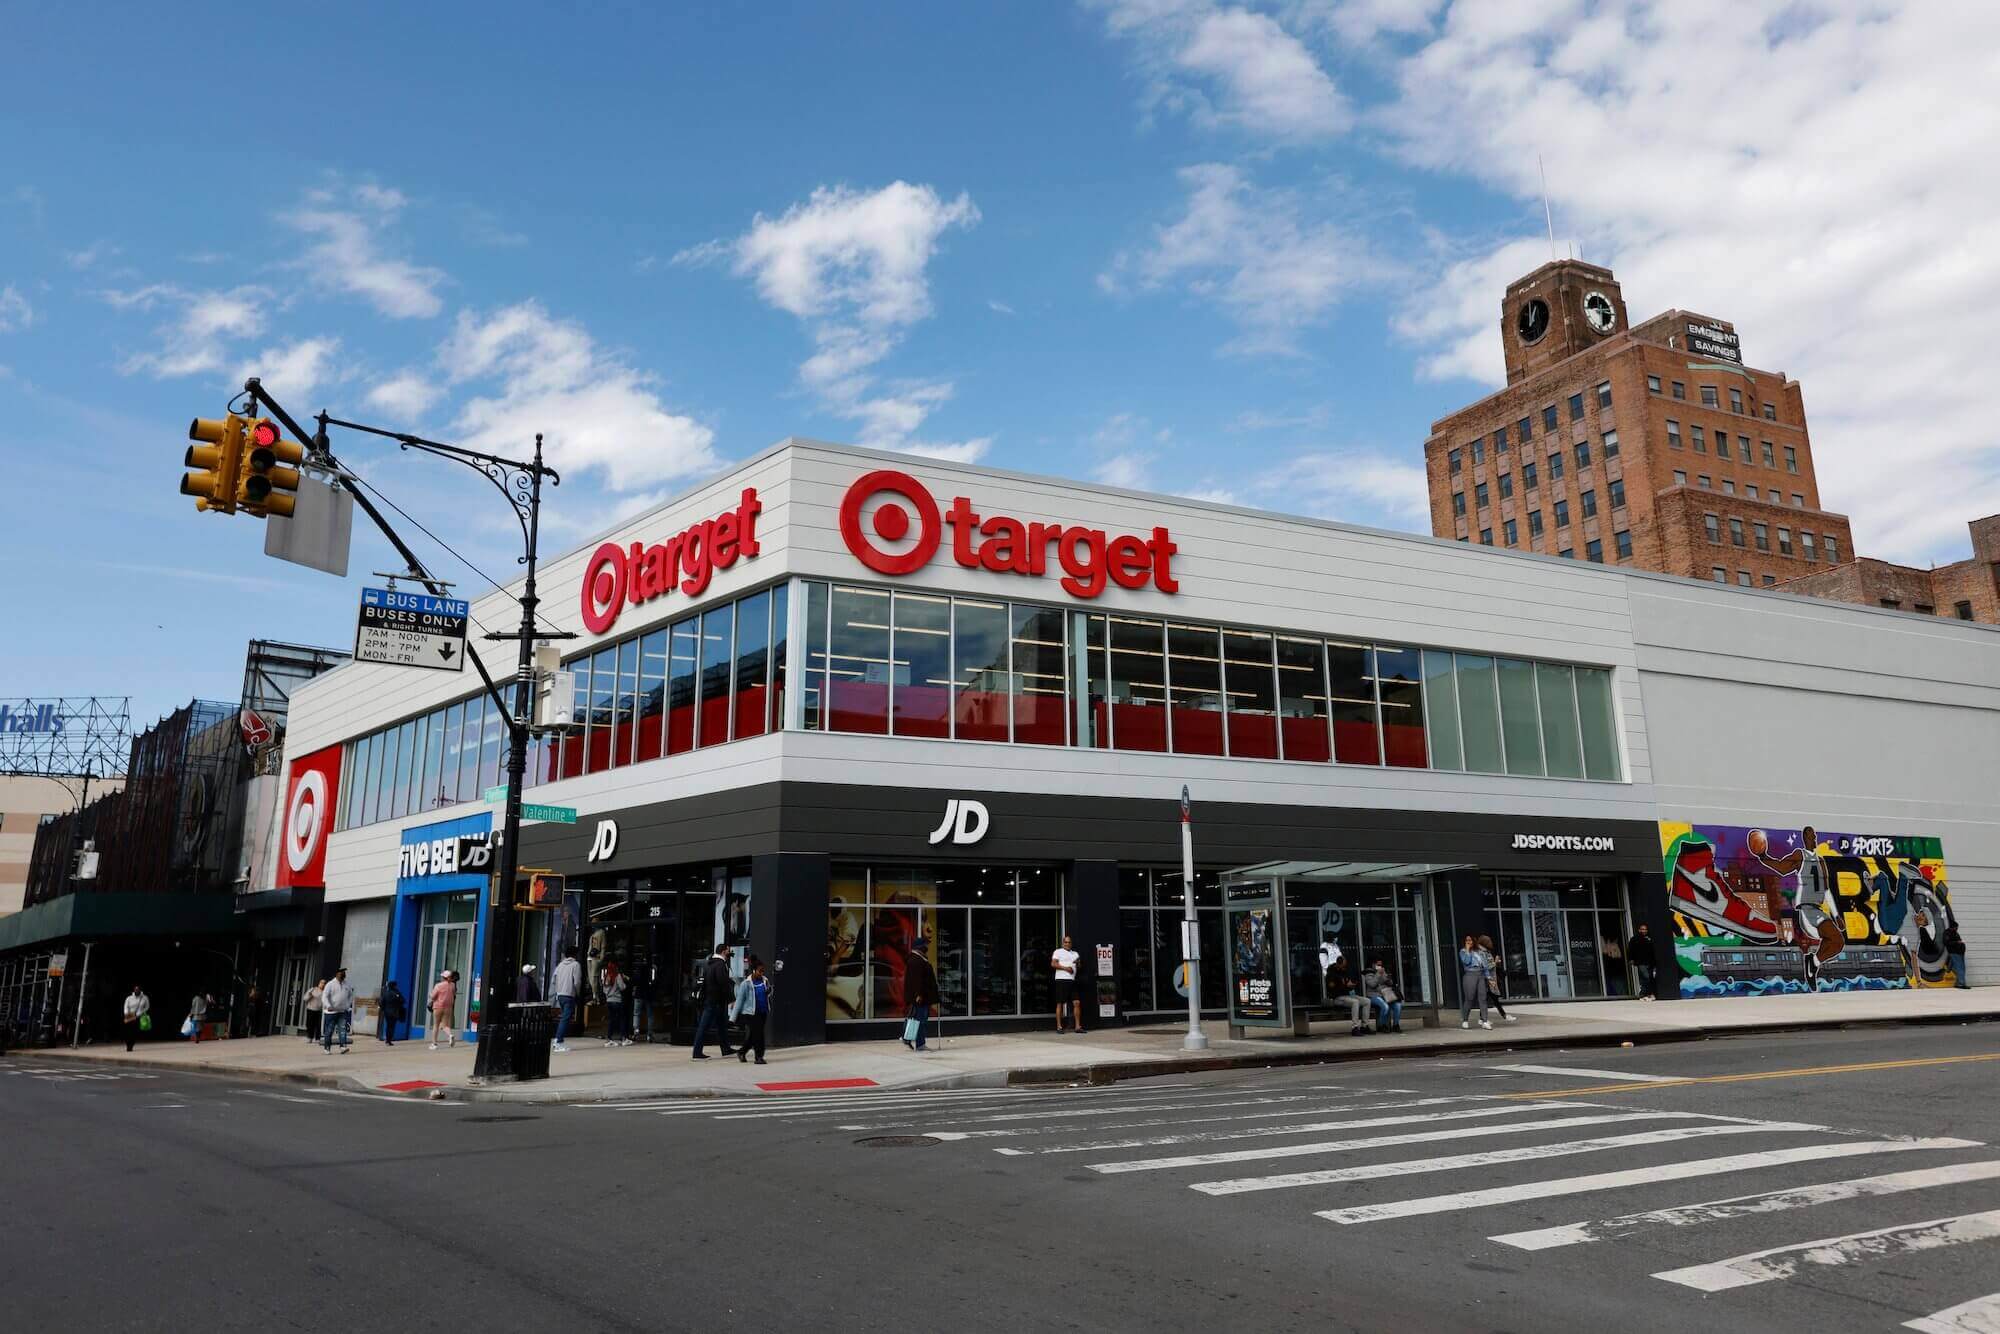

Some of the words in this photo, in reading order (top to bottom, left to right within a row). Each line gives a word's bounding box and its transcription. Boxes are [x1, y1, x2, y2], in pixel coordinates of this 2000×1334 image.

[1688, 324, 1737, 344] EMIGNT
[1695, 340, 1737, 359] SAVINGS
[627, 487, 762, 607] target
[946, 496, 1179, 599] target
[386, 593, 418, 609] BUS
[424, 599, 465, 615] LANE
[366, 607, 417, 623] BUSES
[423, 614, 461, 628] ONLY
[367, 628, 388, 638] 7AM
[398, 632, 428, 643] NOON
[392, 623, 416, 632] RIGHT
[418, 626, 443, 634] TURNS
[365, 639, 388, 649] 2PM
[399, 643, 421, 653] 7PM
[363, 650, 387, 660] MON
[397, 653, 415, 663] FRI
[523, 805, 566, 821] Valentine
[929, 799, 990, 845] JD
[588, 819, 618, 863] JD
[1511, 834, 1614, 851] JDSPORTS.COM
[1852, 836, 1895, 856] SPORTS
[461, 846, 490, 867] JD
[1322, 907, 1340, 926] JD
